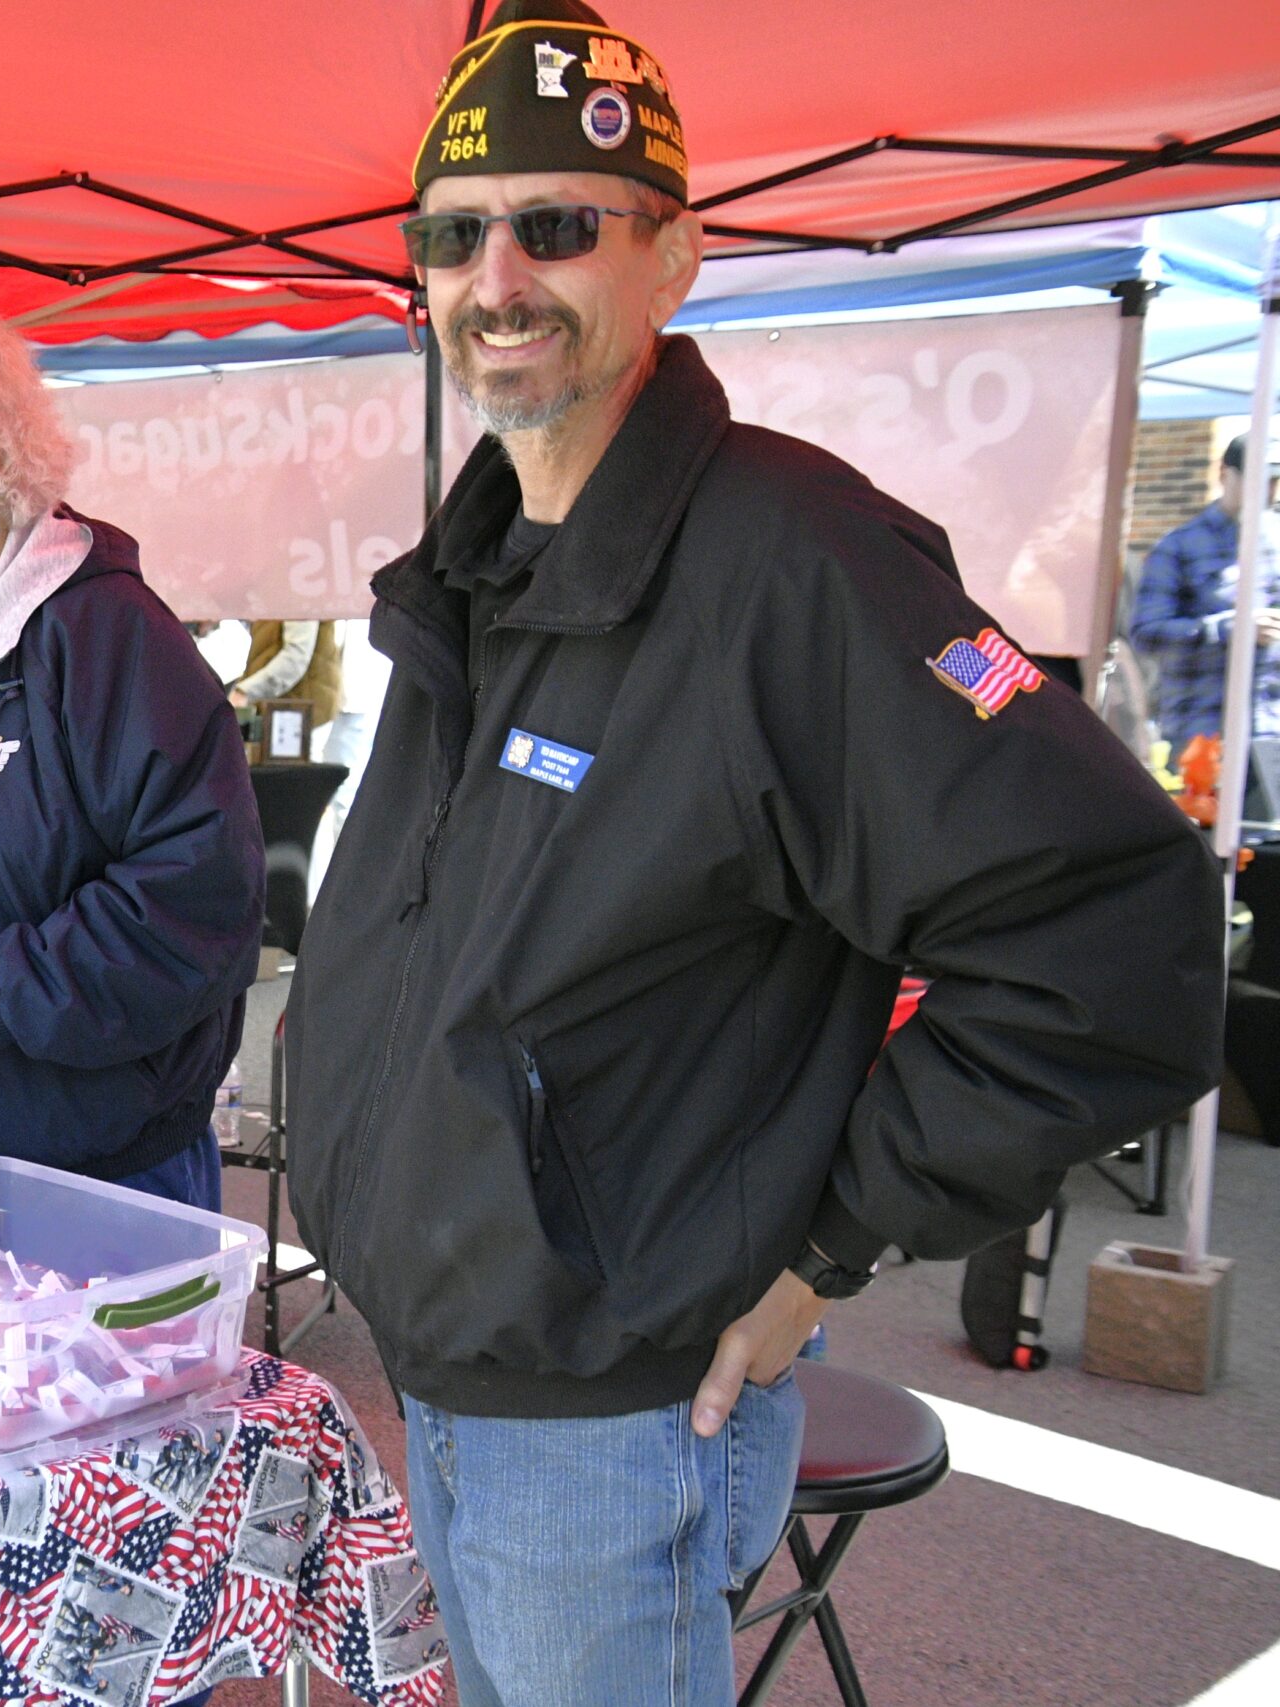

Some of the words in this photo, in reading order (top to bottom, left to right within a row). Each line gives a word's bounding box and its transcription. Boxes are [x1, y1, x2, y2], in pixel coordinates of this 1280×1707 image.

[447, 106, 487, 136] VFW
[637, 104, 683, 149] MAPLE
[440, 134, 488, 162] 7664
[254, 1456, 273, 1509] HEROES
[269, 1458, 281, 1484] USA
[176, 1497, 193, 1516] 2001
[314, 1500, 332, 1523] 2001
[370, 1566, 385, 1621] HEROES
[34, 1641, 54, 1671] 2001
[226, 1661, 252, 1675] USA
